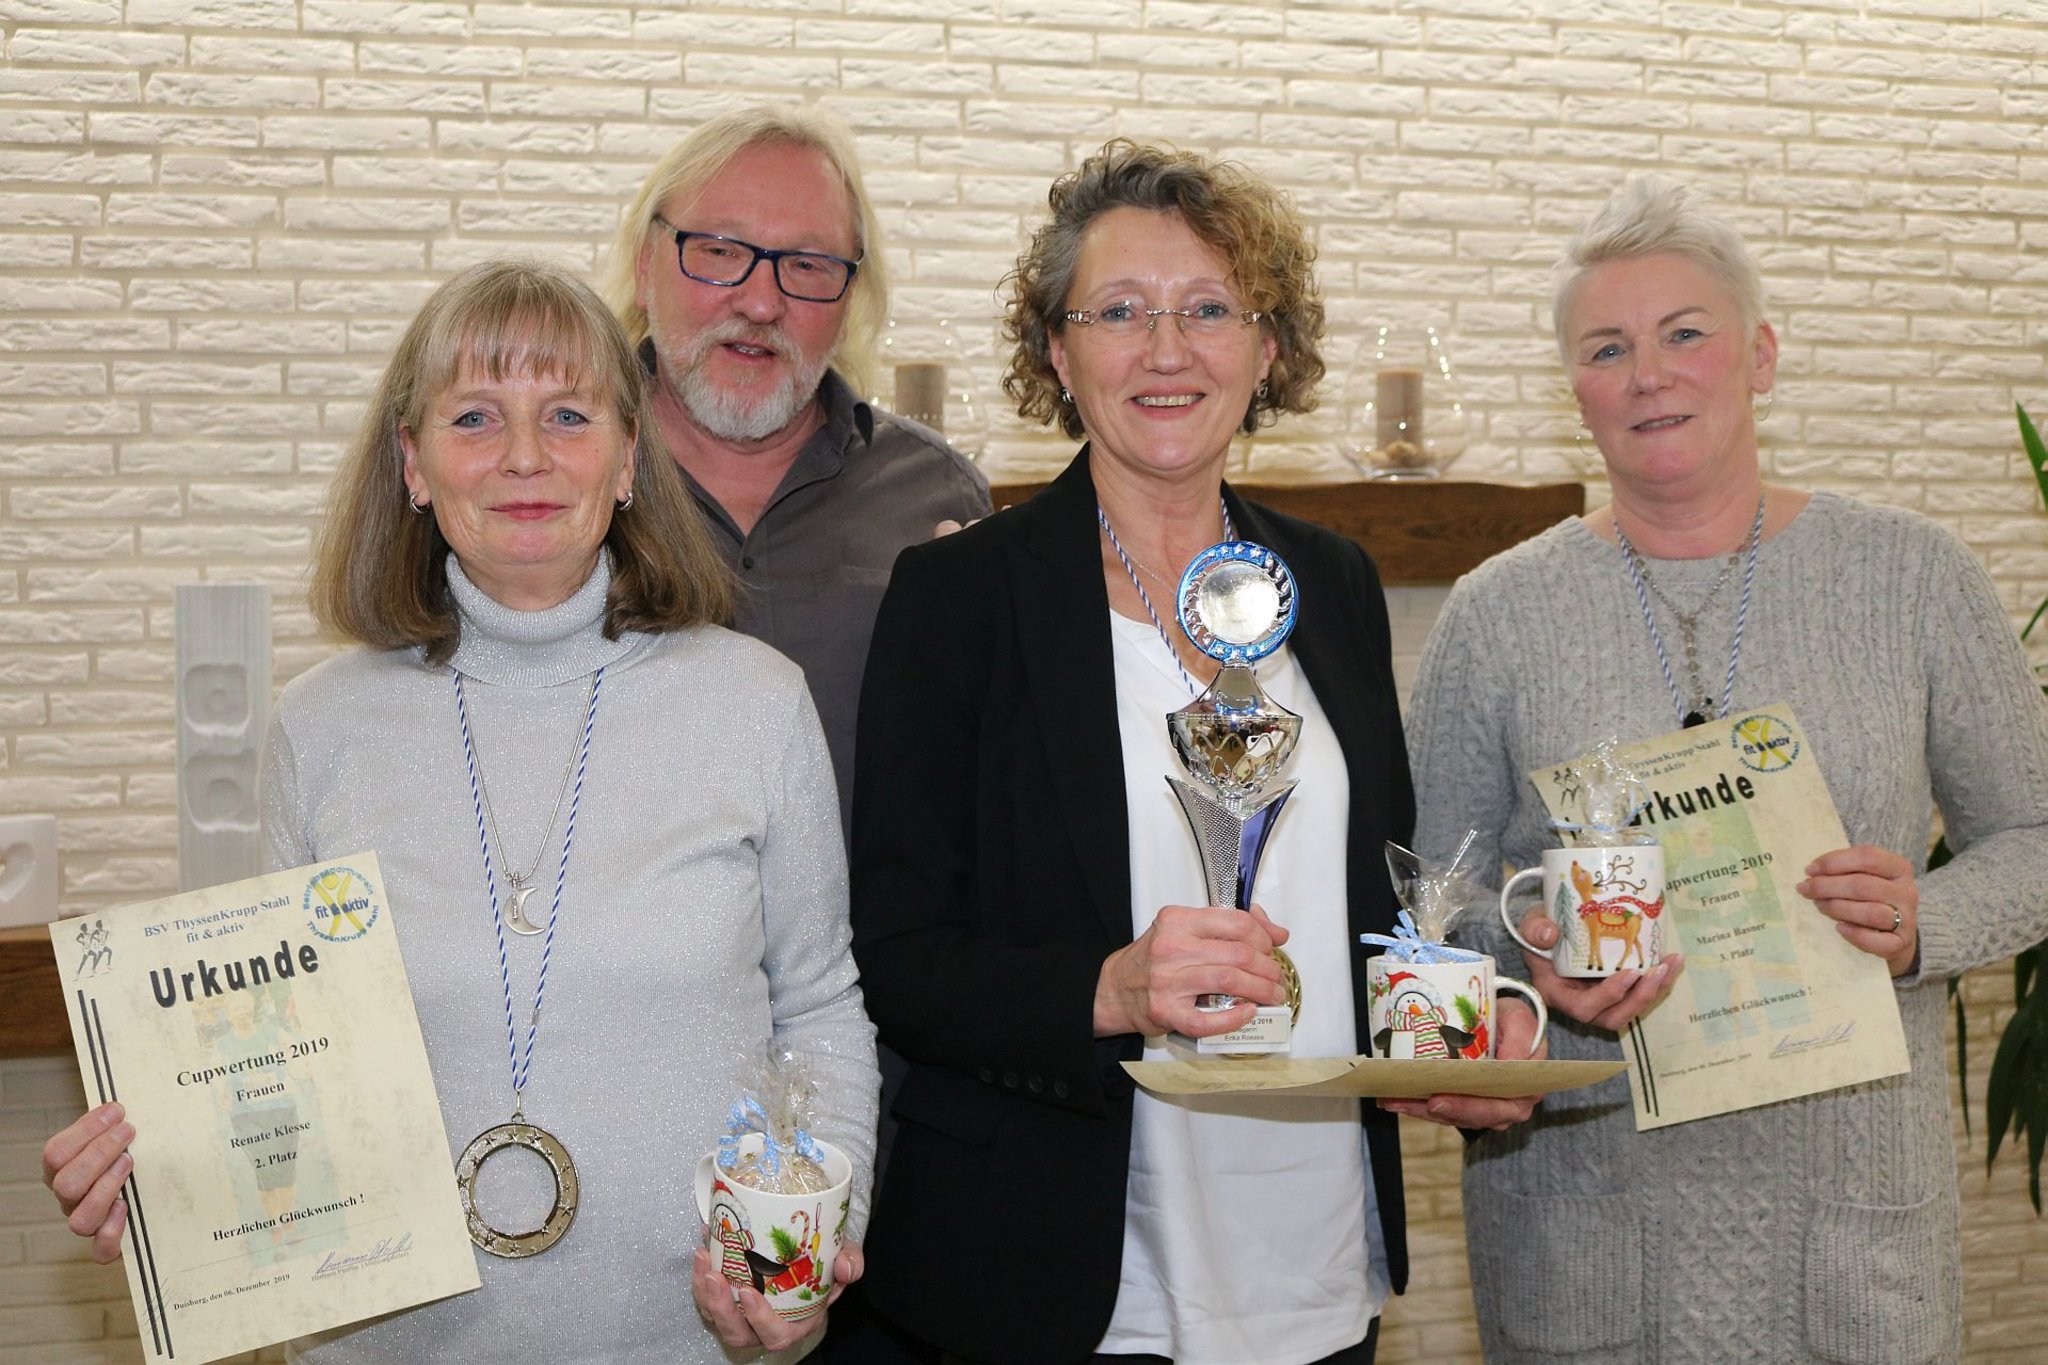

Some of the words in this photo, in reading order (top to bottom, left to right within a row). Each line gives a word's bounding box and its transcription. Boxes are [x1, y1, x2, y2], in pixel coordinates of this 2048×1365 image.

[1629, 773, 1755, 827] rkunde
[1665, 864, 1739, 892] upwertung
[1740, 852, 1773, 870] 2019
[315, 904, 330, 919] fit
[1700, 890, 1741, 907] Frauen
[144, 923, 169, 937] BSV
[173, 904, 258, 931] ThyssenKrupp
[260, 895, 291, 911] Stahl
[186, 932, 199, 943] fit
[202, 928, 213, 940] &
[217, 921, 245, 937] aktiv
[1696, 931, 1731, 945] Marina
[1730, 948, 1754, 960] Platz
[149, 940, 319, 1008] Urkunde
[1689, 1005, 1740, 1024] Herzlichen
[1741, 988, 1806, 1011] Glückwunsch
[176, 1051, 287, 1087] Cupwertung
[290, 1036, 329, 1059] 2019
[236, 1082, 285, 1102] Frauen
[230, 1131, 271, 1149] Renate
[274, 1121, 311, 1138] Klesse
[254, 1158, 266, 1169] 2.
[268, 1151, 298, 1166] Platz
[213, 1219, 277, 1242] Herzlichen
[279, 1196, 357, 1224] Glückwunsch
[173, 1296, 209, 1311] Duisburg,
[209, 1293, 223, 1301] den
[236, 1279, 271, 1294] Dezember
[273, 1273, 291, 1284] 2019
